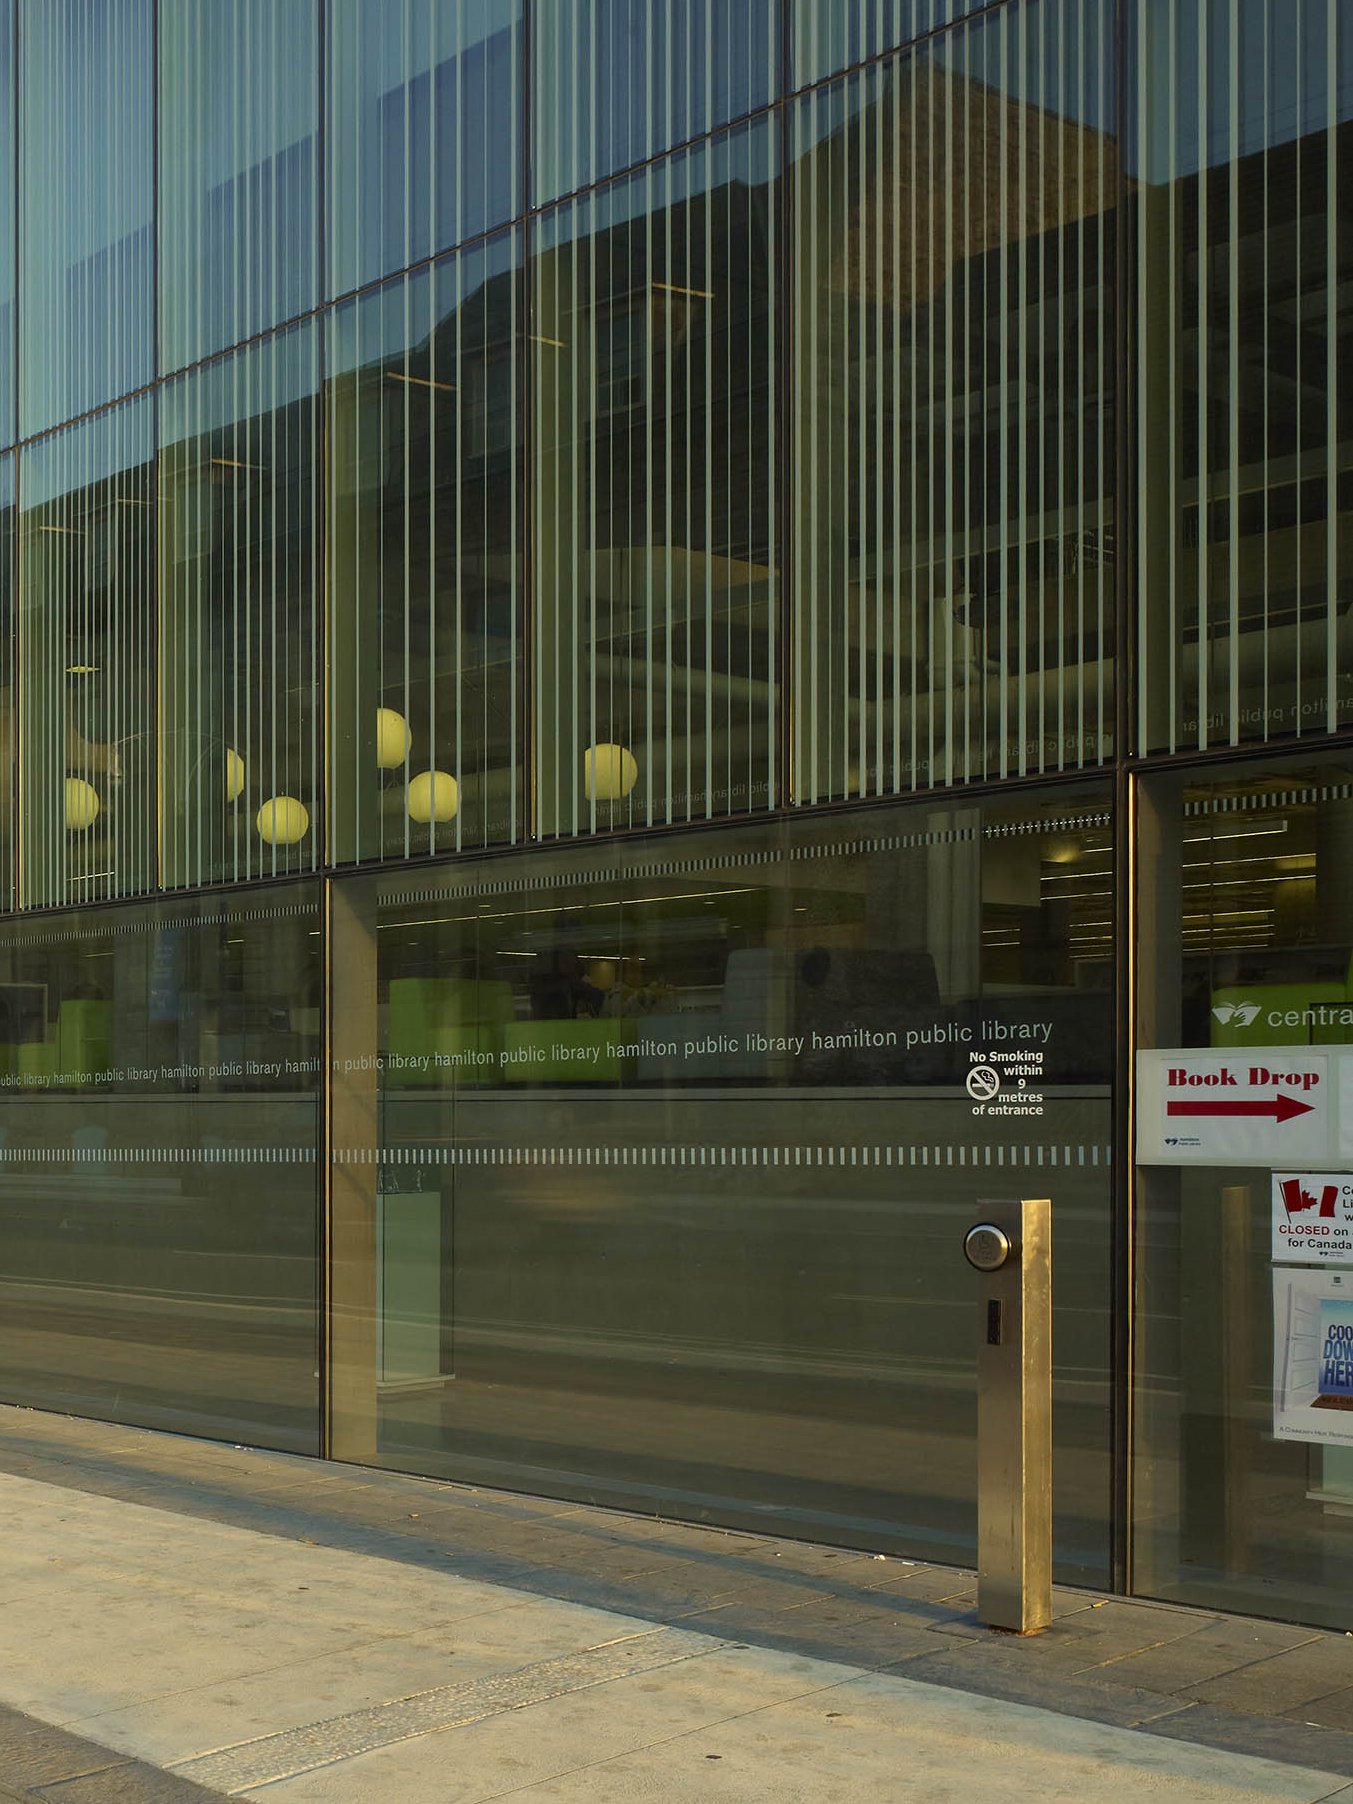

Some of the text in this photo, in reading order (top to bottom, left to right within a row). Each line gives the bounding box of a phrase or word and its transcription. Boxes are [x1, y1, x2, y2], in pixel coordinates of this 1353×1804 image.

[23, 1071, 51, 1088] library
[53, 1068, 92, 1084] hamilton
[95, 1067, 124, 1084] public
[127, 1065, 158, 1083] library
[161, 1063, 205, 1079] hamilton
[209, 1060, 243, 1080] public
[246, 1056, 281, 1077] library
[344, 1054, 384, 1074] public
[388, 1052, 430, 1073] library
[434, 1049, 494, 1066] hamilton
[500, 1047, 546, 1068] public
[551, 1043, 600, 1064] library
[606, 1040, 677, 1058] hamilton
[684, 1035, 739, 1062] public
[746, 1033, 804, 1055] library
[812, 1029, 897, 1050] hamilton
[906, 1022, 972, 1049] public
[982, 1020, 1053, 1043] library
[969, 1050, 1044, 1063] No Smoking
[1003, 1065, 1043, 1076] within
[1017, 1078, 1026, 1089] 9
[1167, 1067, 1319, 1091] Book Drop
[998, 1092, 1044, 1103] metres
[972, 1104, 1044, 1115] of entrance
[1278, 1224, 1349, 1236] CLOSED on
[1287, 1237, 1352, 1249] for Canada
